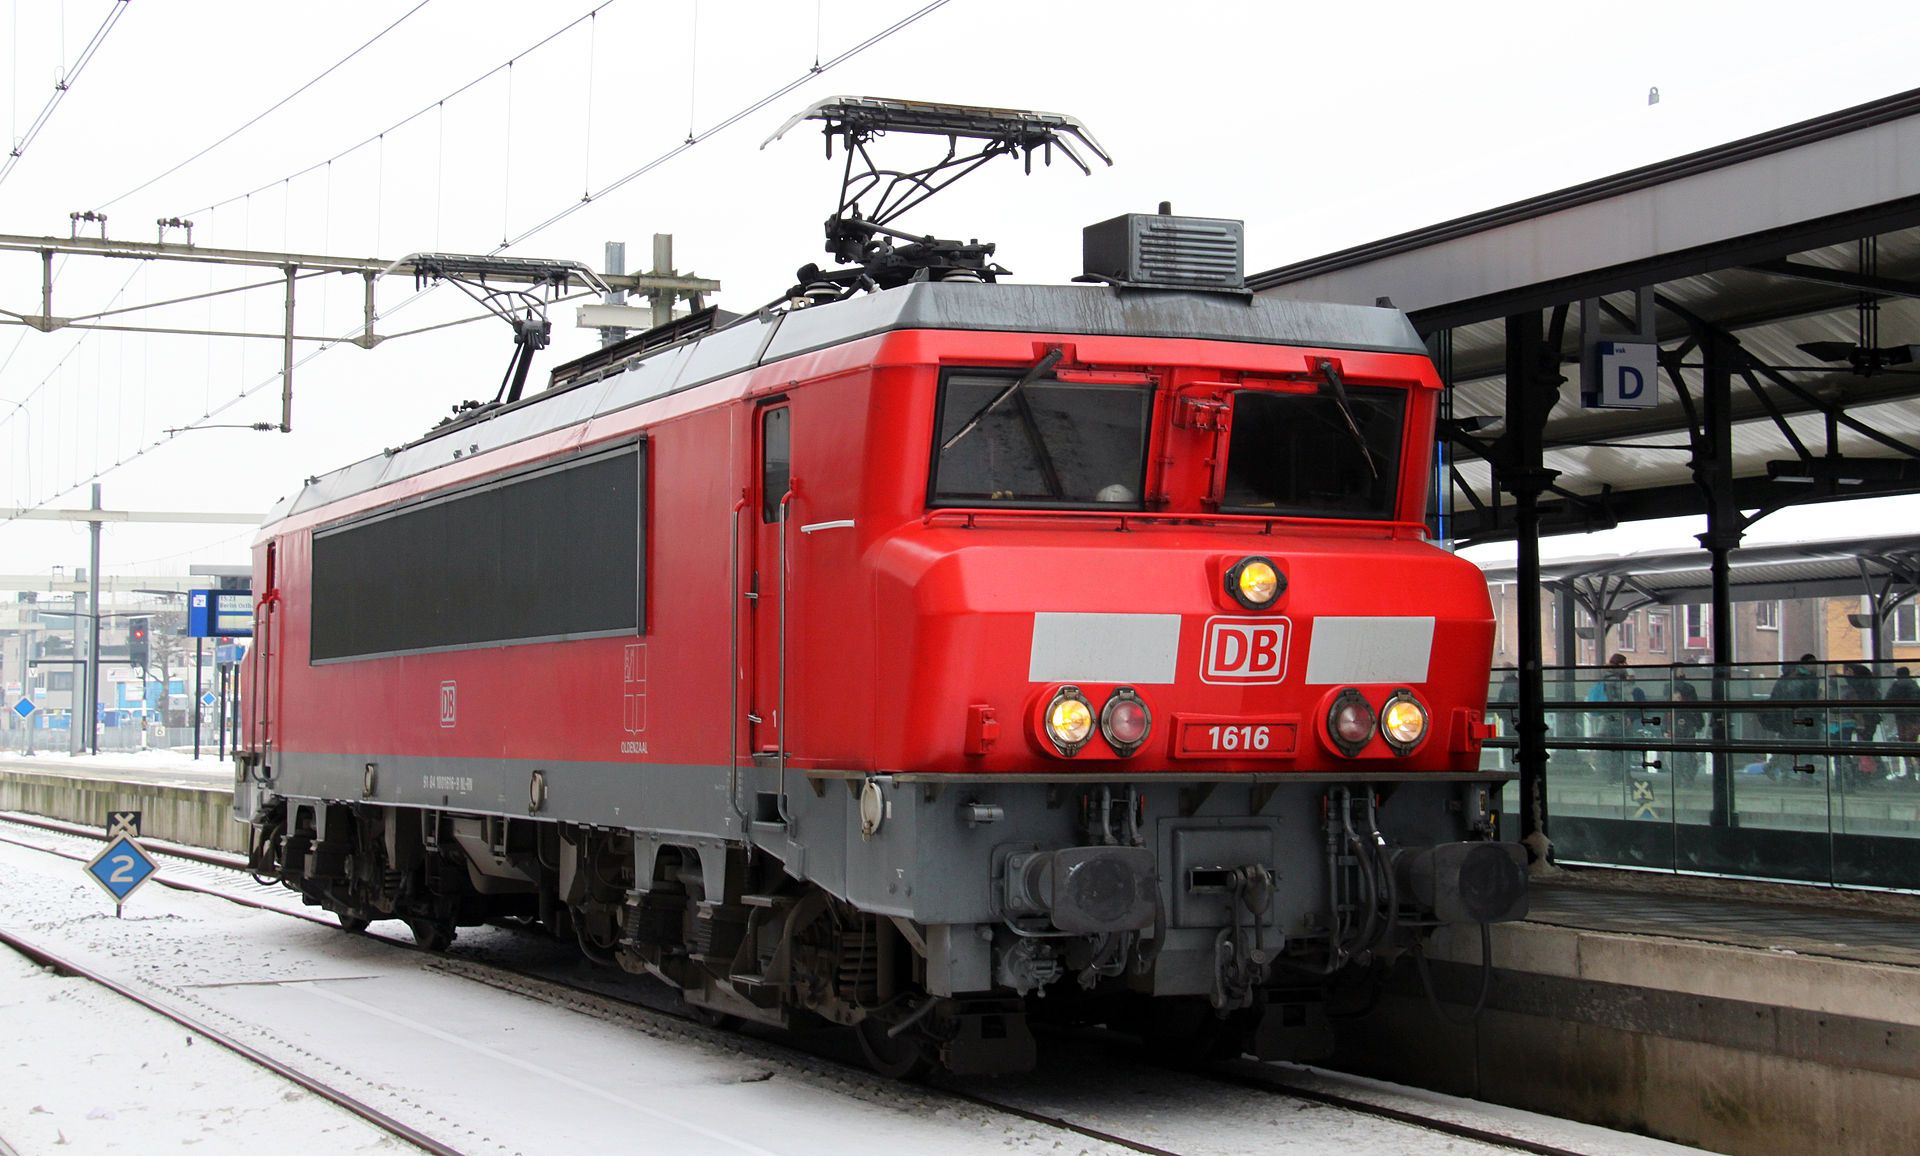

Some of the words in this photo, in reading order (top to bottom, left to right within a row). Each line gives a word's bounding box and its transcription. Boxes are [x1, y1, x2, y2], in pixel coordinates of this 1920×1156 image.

[1618, 366, 1644, 400] D
[1213, 628, 1279, 673] DB
[442, 687, 454, 720] DB
[620, 741, 649, 754] OLDENZAAL
[1208, 725, 1270, 751] 1616
[110, 854, 135, 882] 2
